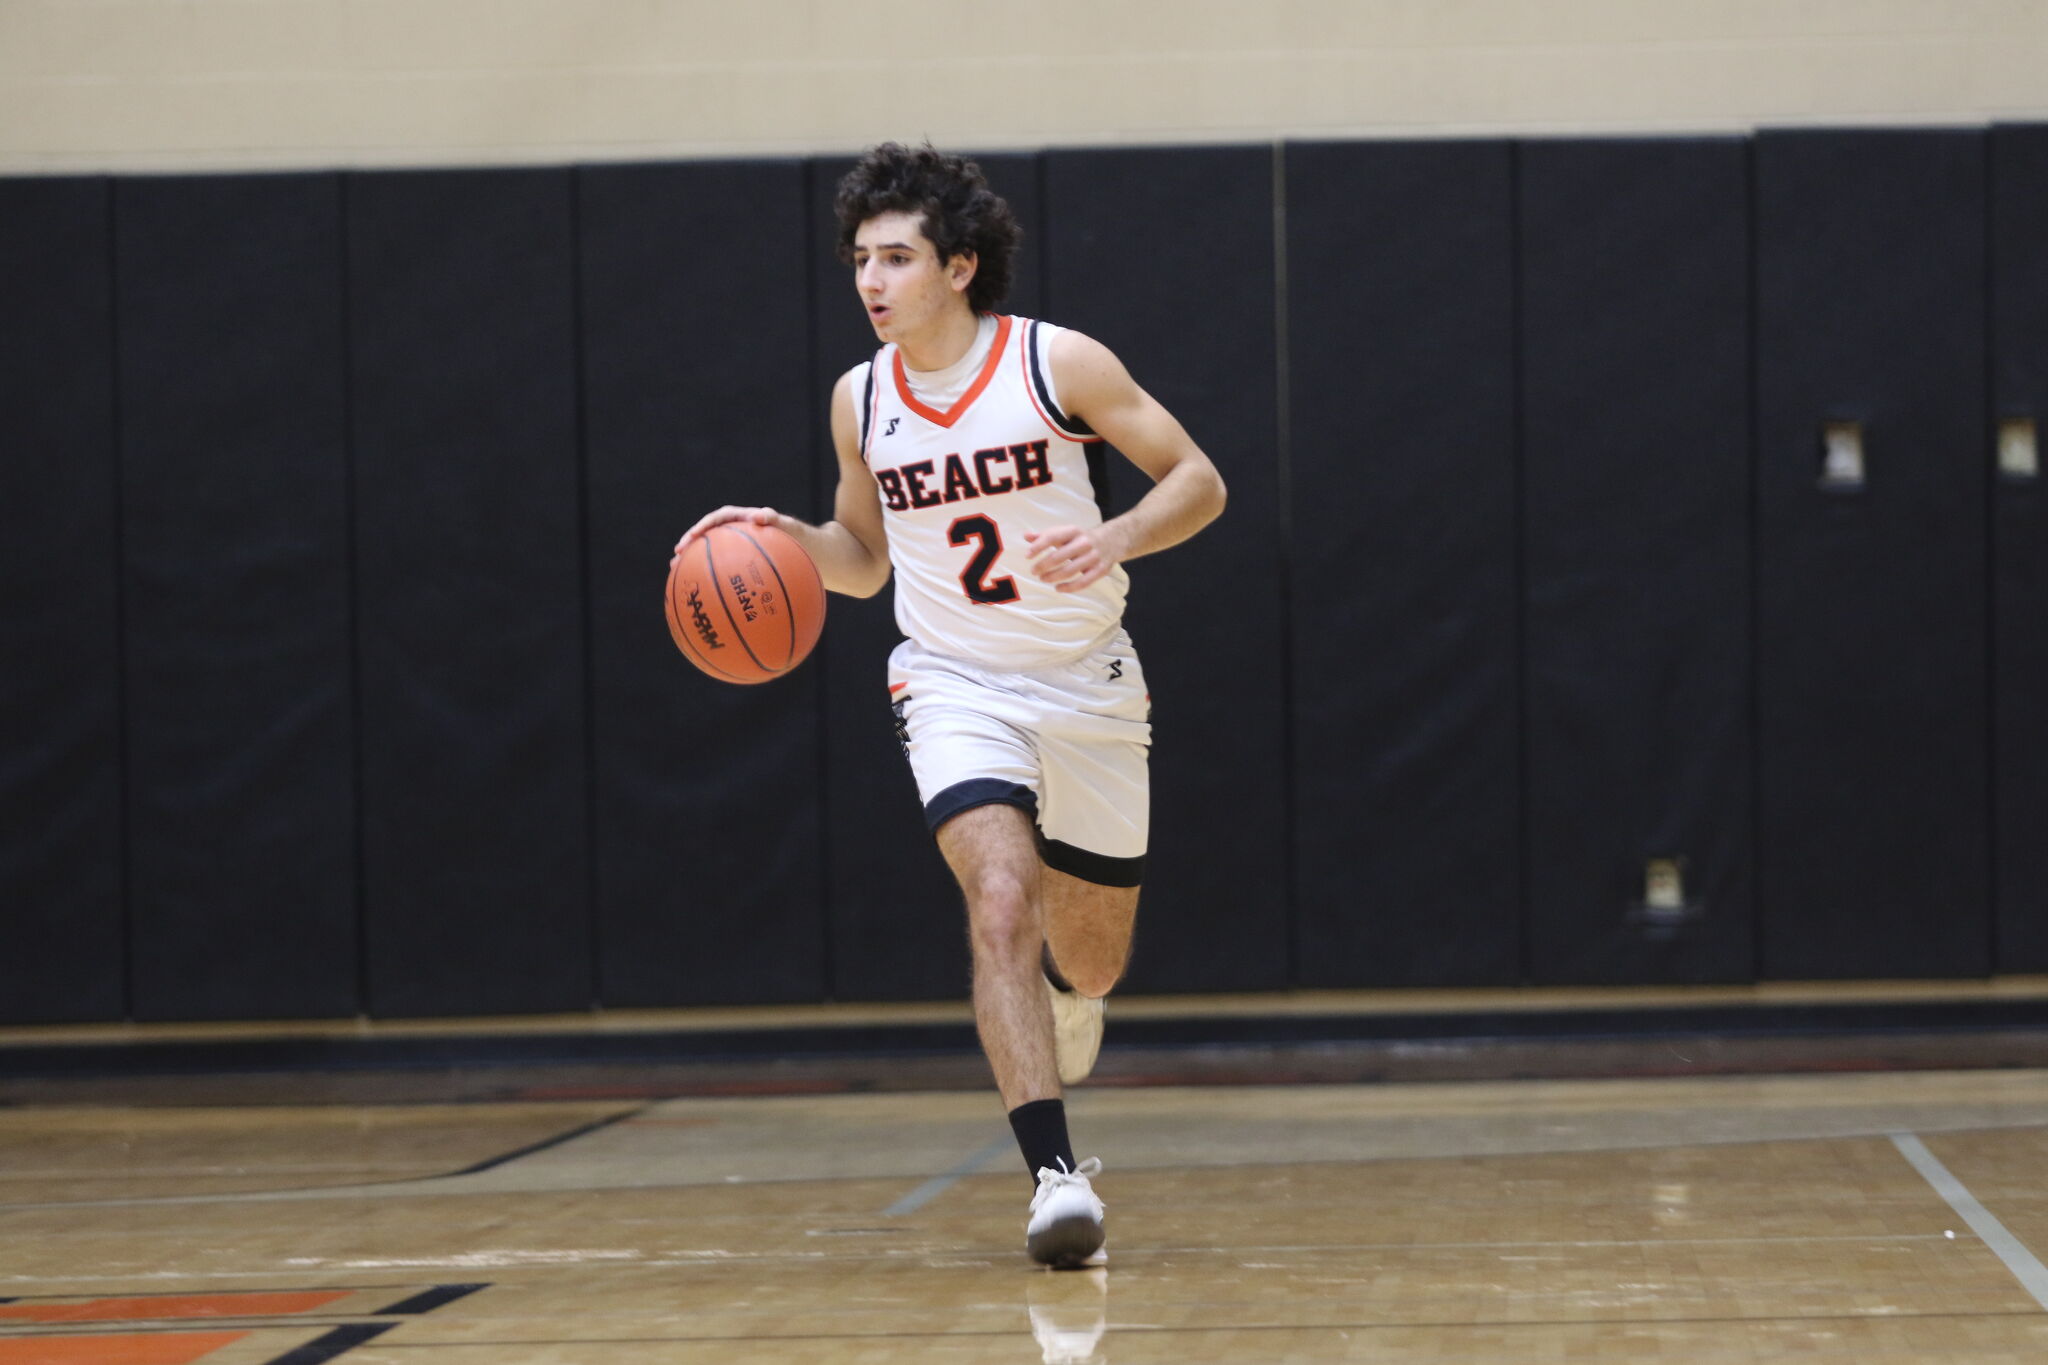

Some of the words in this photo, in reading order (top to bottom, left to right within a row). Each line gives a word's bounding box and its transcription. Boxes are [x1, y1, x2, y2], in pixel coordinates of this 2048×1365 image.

[875, 438, 1053, 512] BEACH
[730, 575, 755, 614] NFHS
[946, 512, 1022, 606] 2
